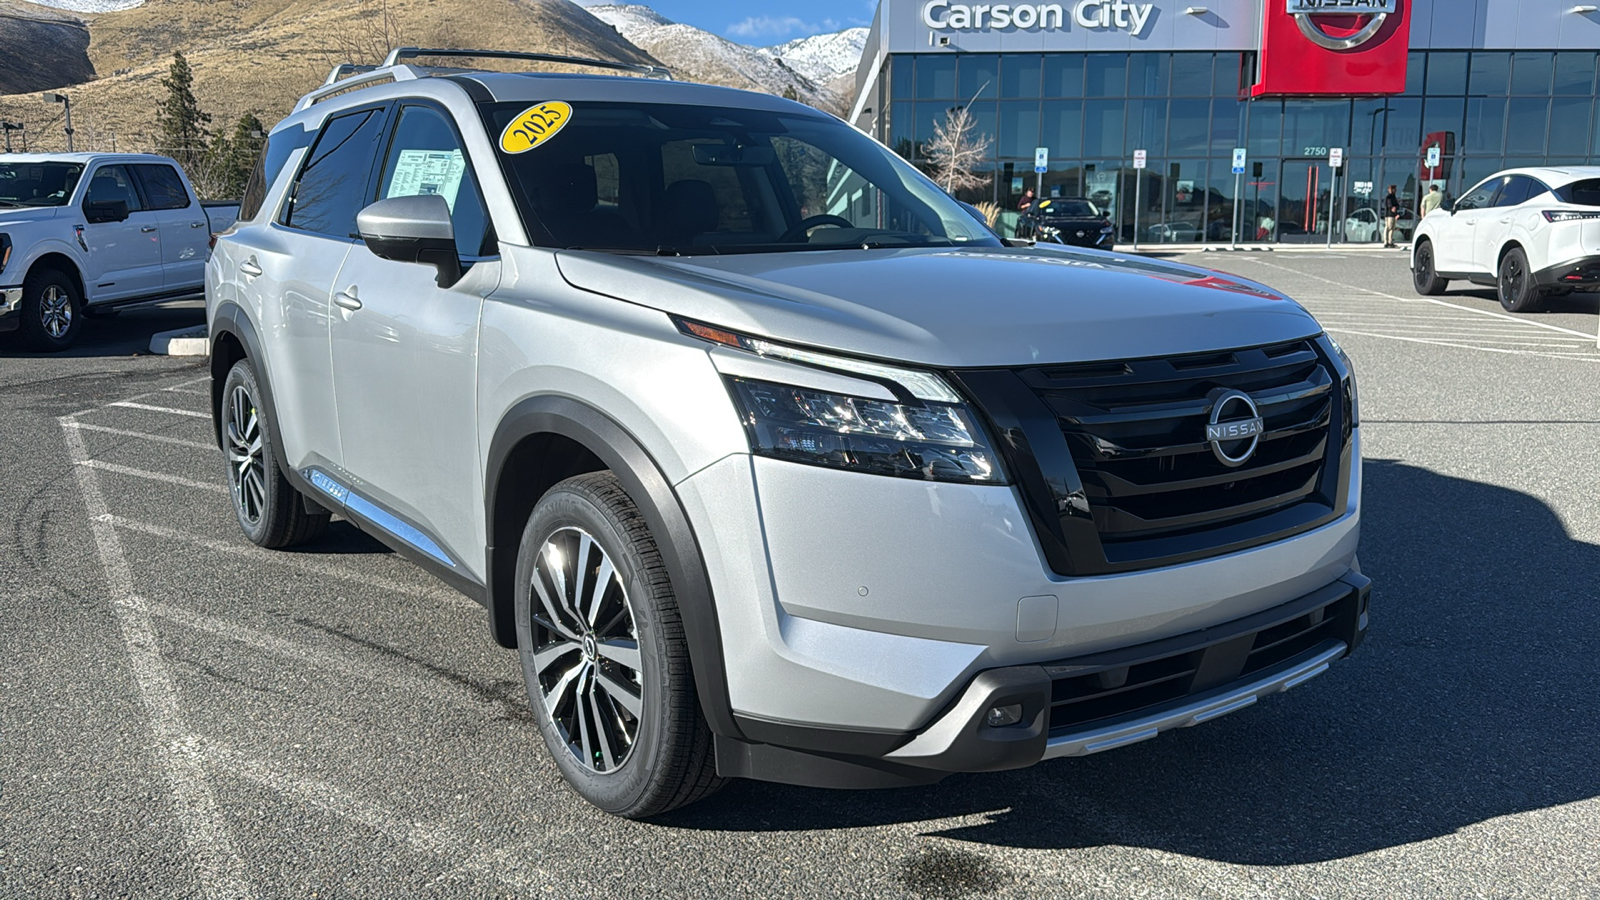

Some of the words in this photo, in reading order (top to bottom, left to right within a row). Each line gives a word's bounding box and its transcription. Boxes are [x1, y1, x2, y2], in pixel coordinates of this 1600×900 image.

[1299, 0, 1388, 8] NISSAN
[922, 0, 1063, 29] Carson
[1074, 0, 1153, 36] City
[513, 105, 562, 145] 2025
[1304, 146, 1327, 156] 2750
[1208, 421, 1263, 438] NISSAN
